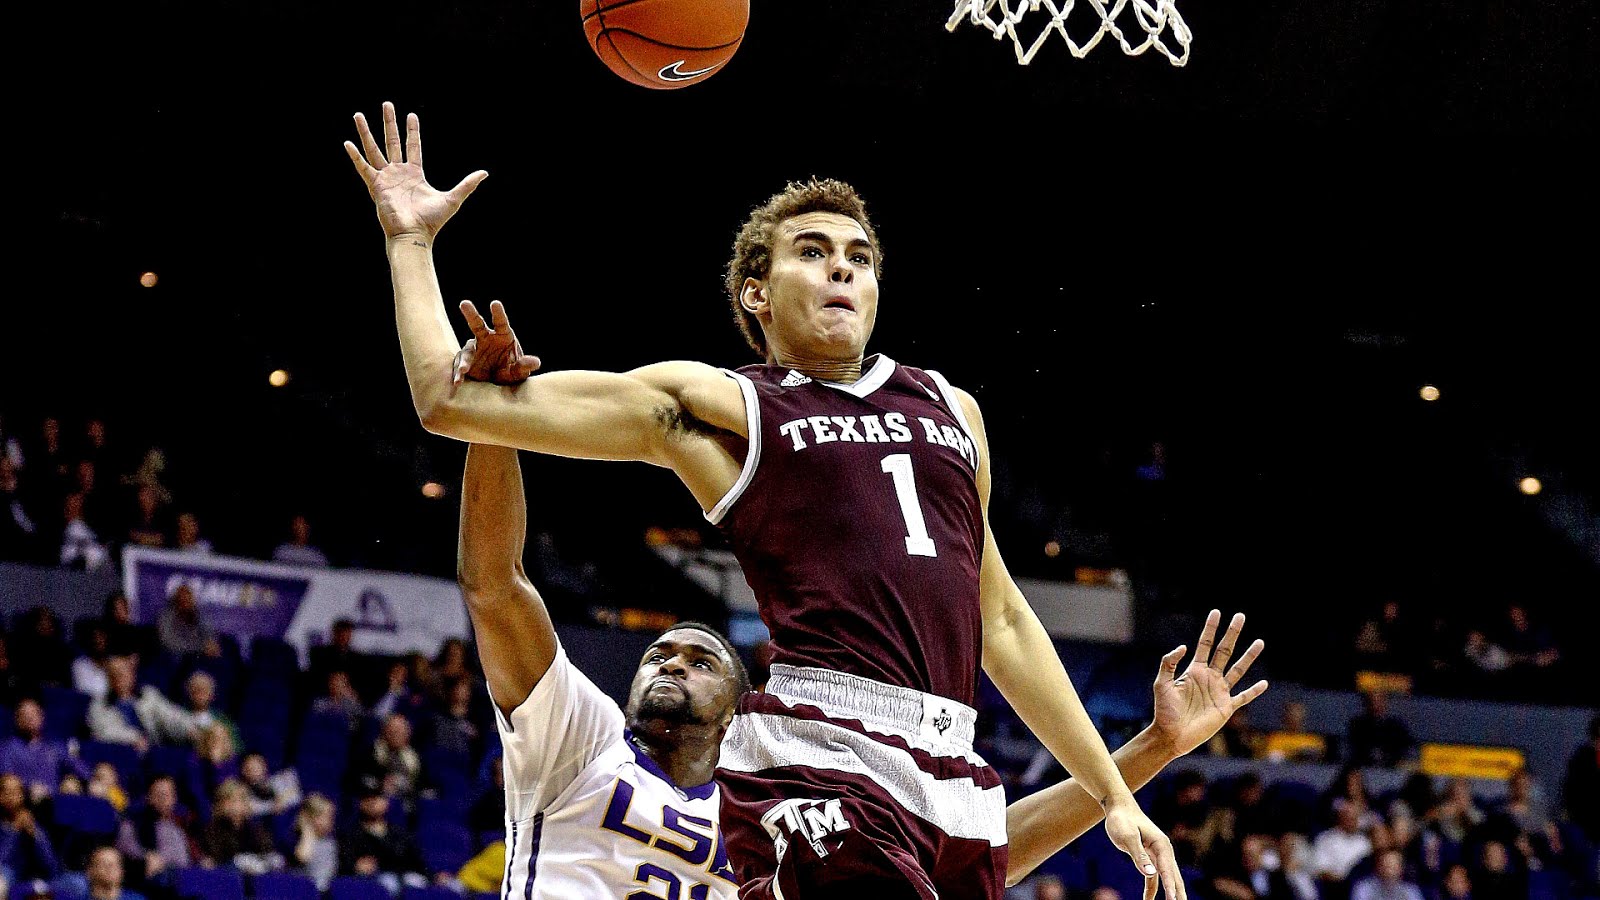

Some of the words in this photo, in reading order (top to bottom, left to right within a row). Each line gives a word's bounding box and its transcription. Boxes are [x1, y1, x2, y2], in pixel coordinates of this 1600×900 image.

[780, 412, 913, 452] TEXAS
[918, 417, 976, 470] A&M
[880, 453, 937, 558] 1
